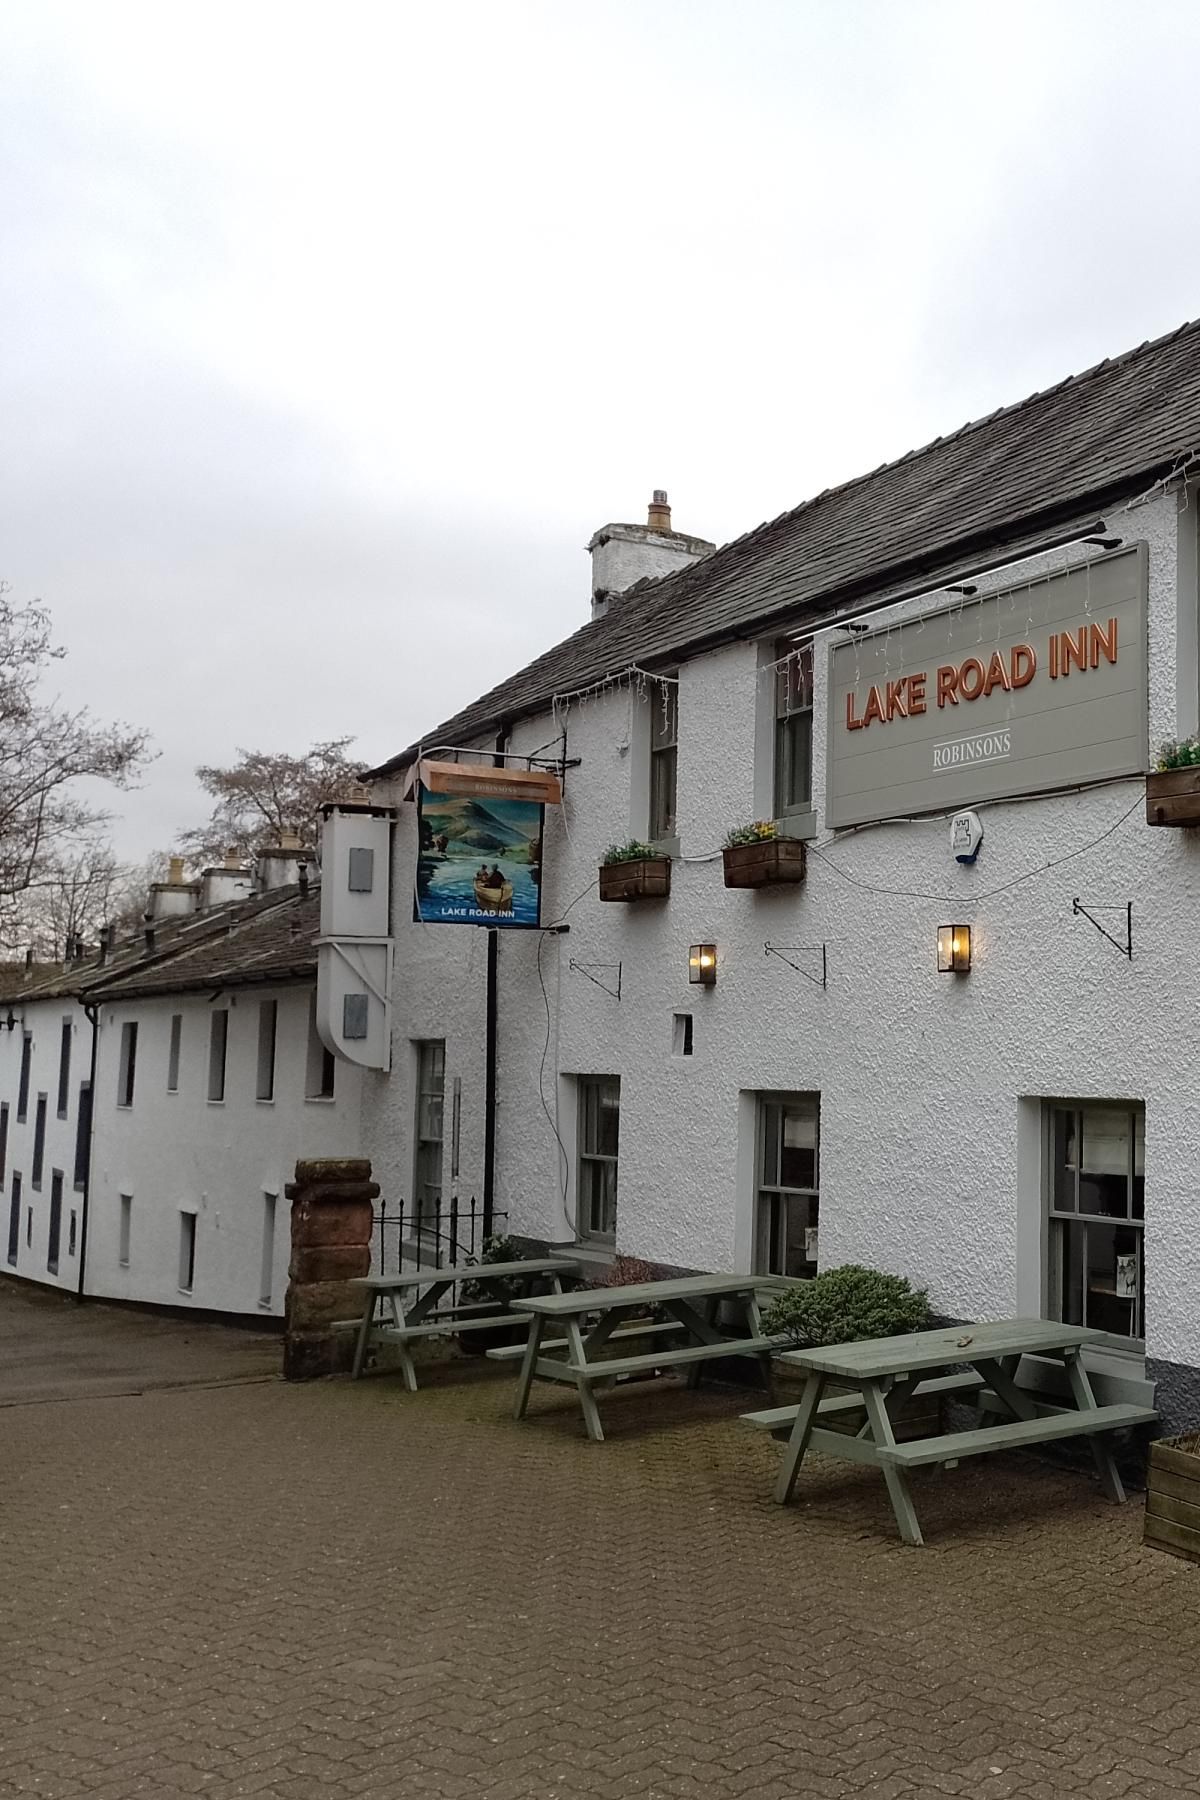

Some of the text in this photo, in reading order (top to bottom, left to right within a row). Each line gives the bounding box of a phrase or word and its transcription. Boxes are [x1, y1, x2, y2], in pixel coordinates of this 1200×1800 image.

[846, 617, 1118, 730] LAKE ROAD INN
[933, 732, 1011, 768] ROBINSONS
[441, 907, 515, 918] LAKE ROAD INN
